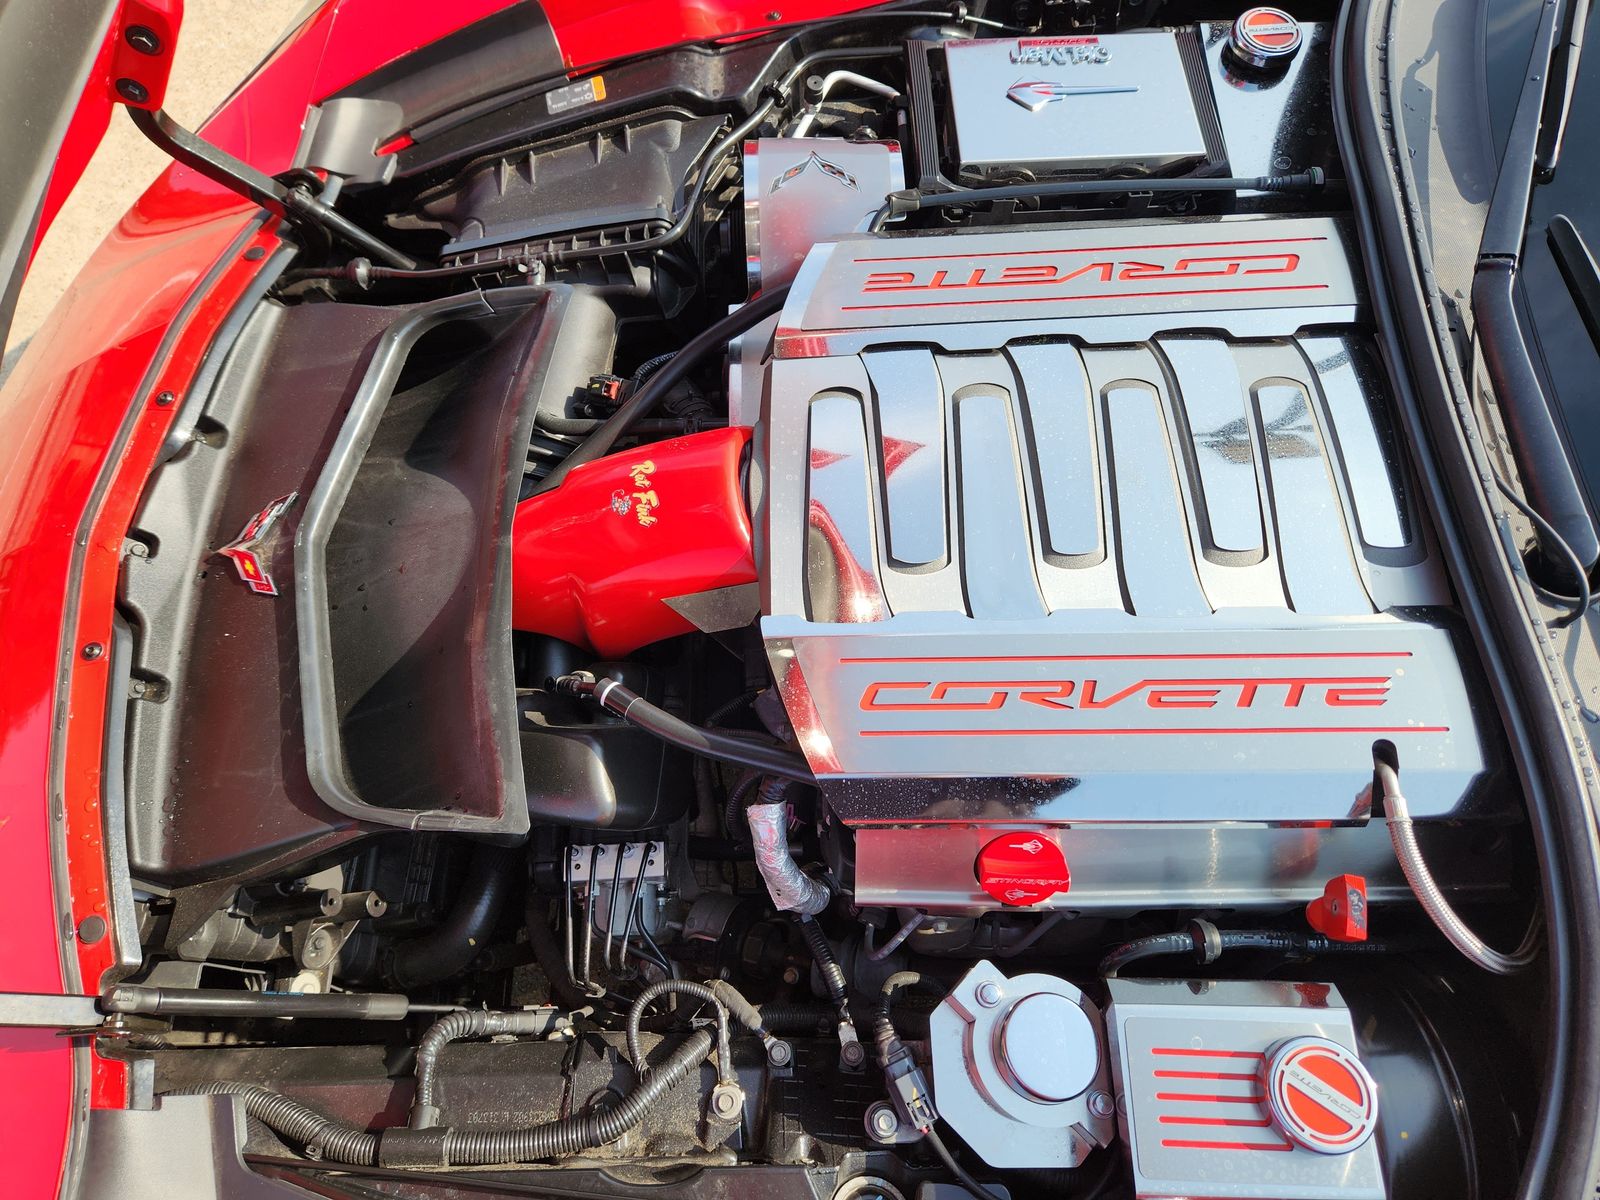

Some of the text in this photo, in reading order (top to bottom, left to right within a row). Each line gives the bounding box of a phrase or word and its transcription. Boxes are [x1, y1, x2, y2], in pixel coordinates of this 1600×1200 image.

[862, 253, 1300, 293] CORVETTE
[629, 460, 659, 528] Rat Fink
[858, 676, 1393, 711] CORVETTE
[985, 877, 1069, 886] STINGRAY
[1289, 1069, 1362, 1120] CORVETTE
